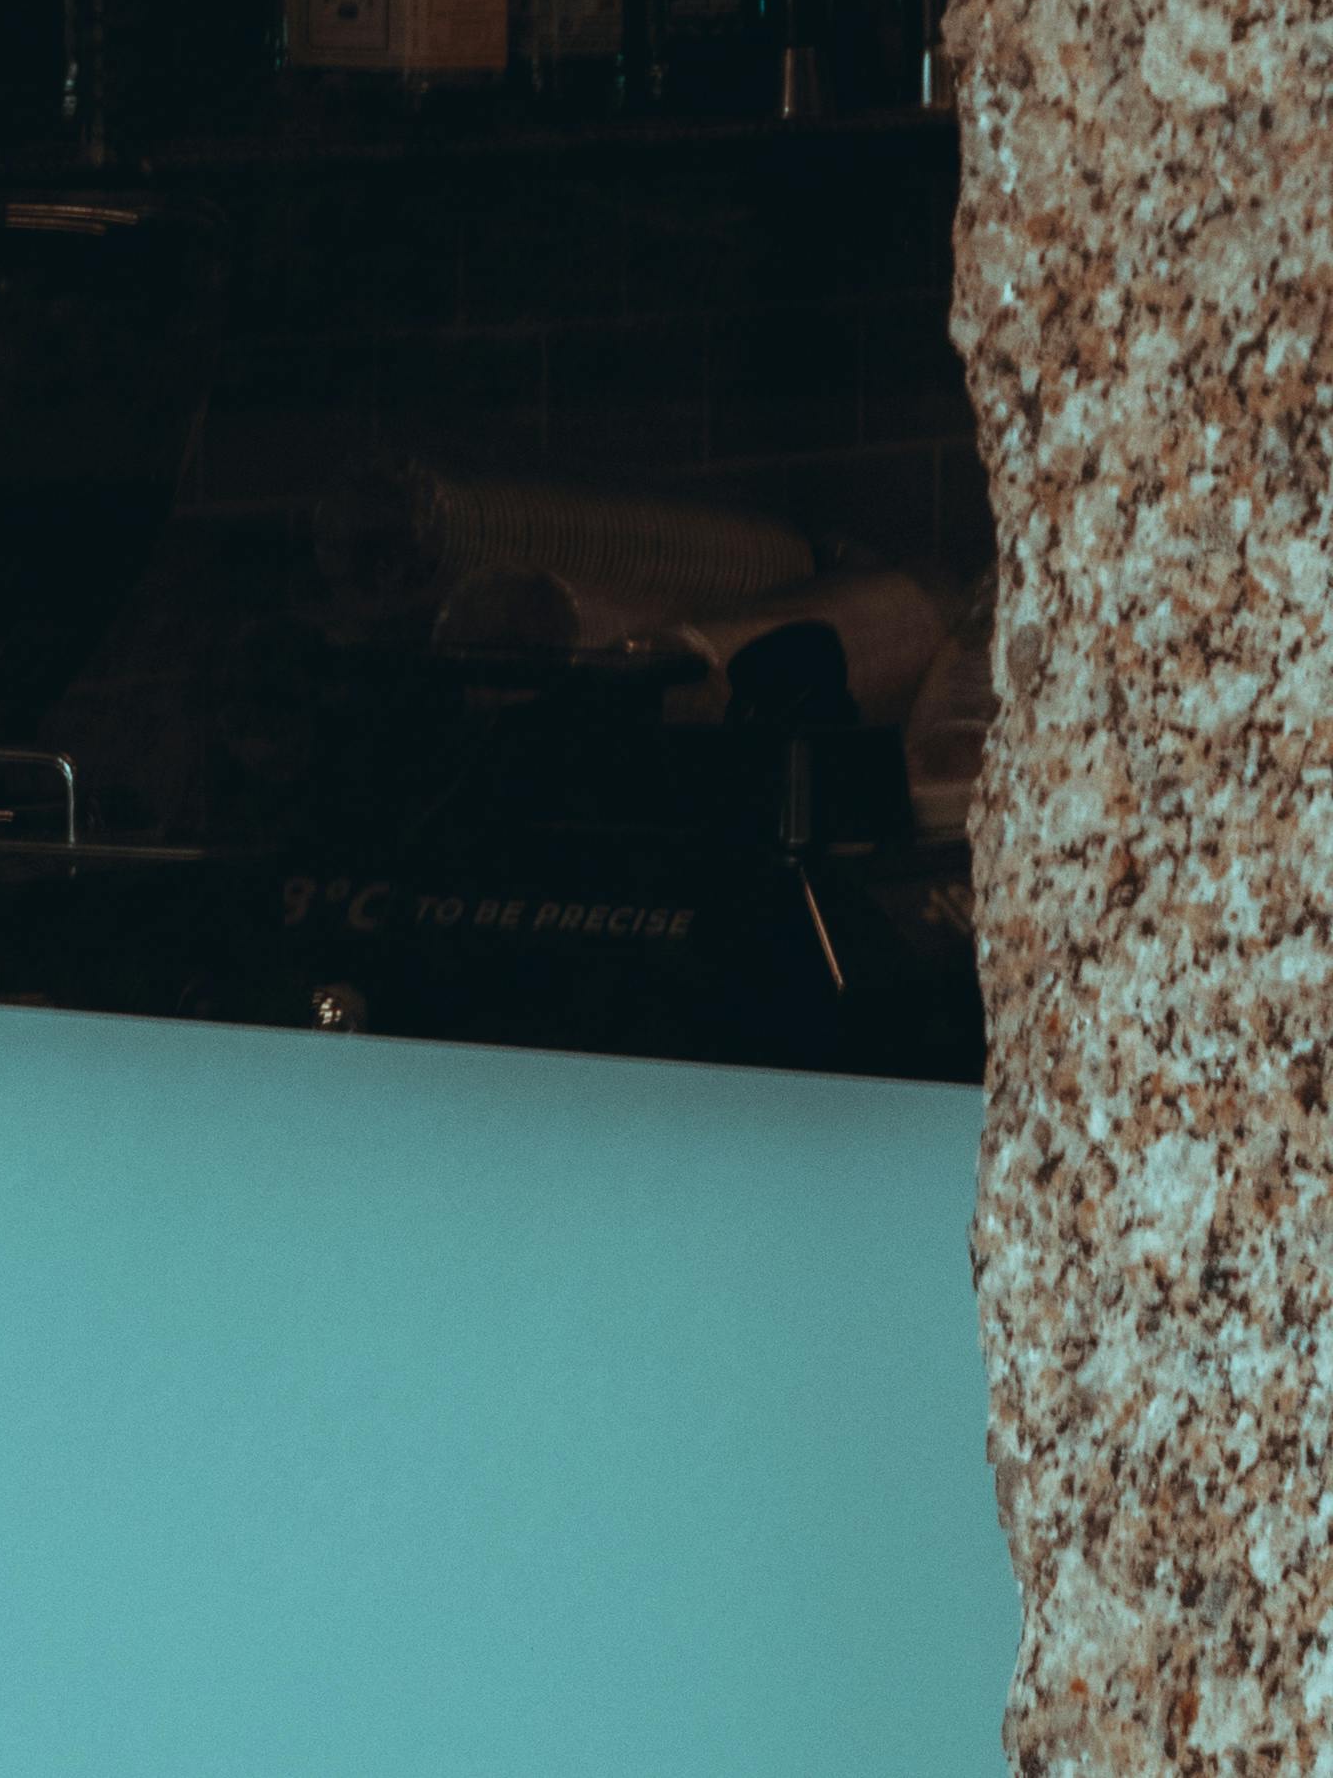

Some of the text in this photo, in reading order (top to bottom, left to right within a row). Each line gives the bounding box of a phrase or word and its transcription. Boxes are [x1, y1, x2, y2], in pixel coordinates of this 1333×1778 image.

[415, 896, 464, 926] TO
[473, 899, 526, 931] BE
[533, 902, 695, 940] PRECISE
